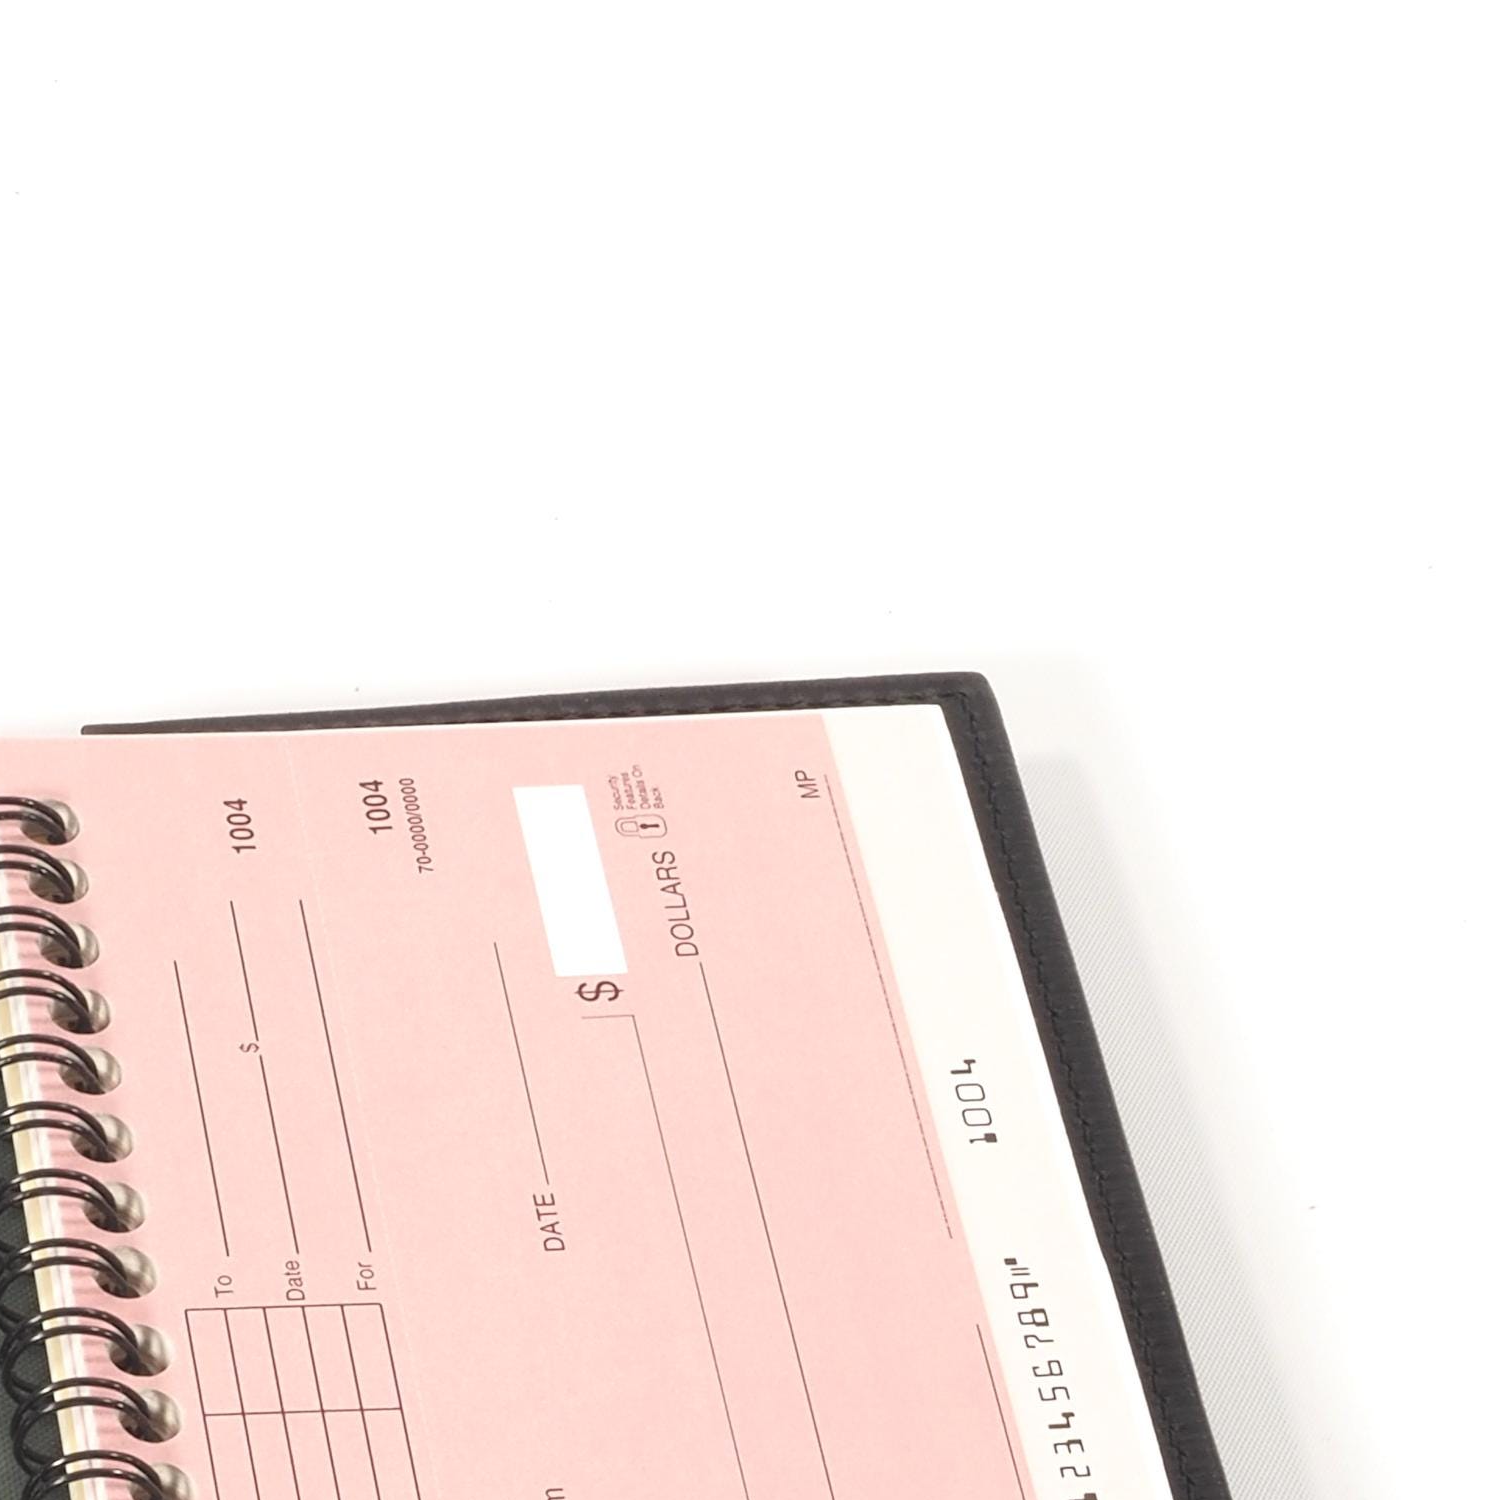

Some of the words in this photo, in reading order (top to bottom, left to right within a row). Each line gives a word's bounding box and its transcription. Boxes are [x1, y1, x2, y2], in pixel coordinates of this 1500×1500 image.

[359, 779, 393, 835] 1004
[795, 769, 821, 800] MP
[223, 798, 257, 854] 1004
[399, 777, 434, 874] 70-0000/0000
[652, 850, 700, 957] DOLLARS
[575, 980, 625, 1002] $
[950, 1059, 998, 1143] 1004
[533, 1192, 566, 1252] DATE
[214, 1274, 234, 1298] To
[284, 1260, 306, 1301] Date
[356, 1262, 377, 1291] For
